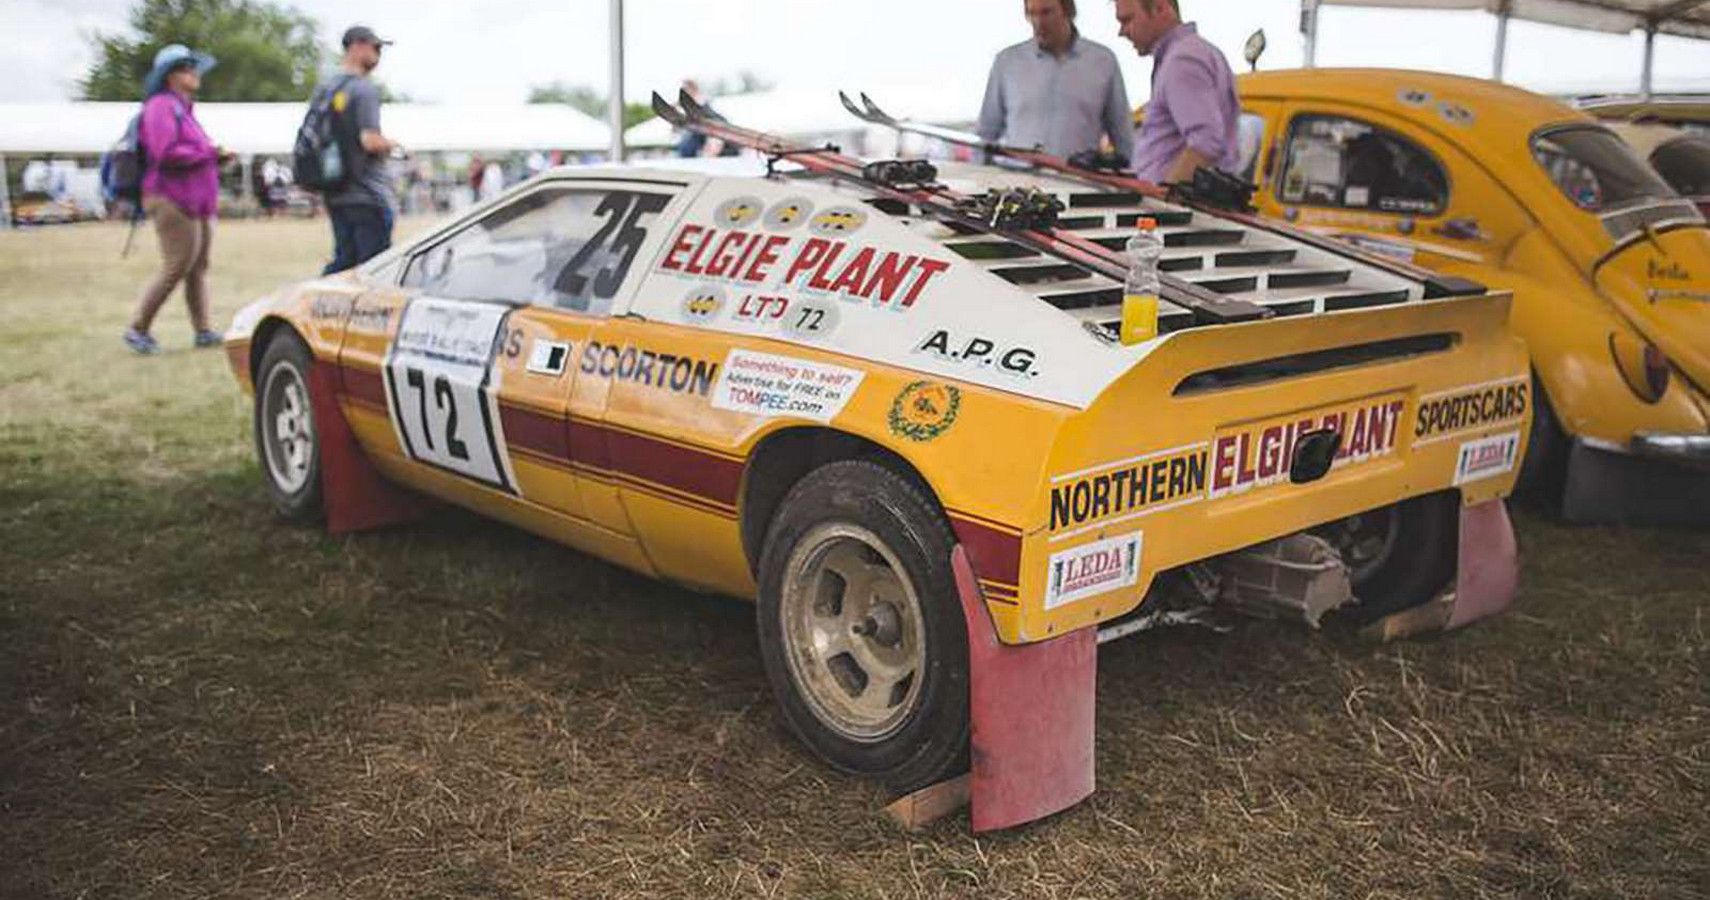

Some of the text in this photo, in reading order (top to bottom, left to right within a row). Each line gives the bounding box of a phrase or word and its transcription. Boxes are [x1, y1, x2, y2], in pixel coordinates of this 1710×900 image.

[553, 191, 674, 299] 25
[661, 223, 951, 309] ELGIE PLANT
[737, 295, 789, 319] LTD
[795, 308, 825, 331] 72
[581, 340, 719, 396] SCORTON
[733, 354, 854, 388] Something to sell?
[921, 329, 1039, 376] A.P.G.
[727, 371, 775, 389] Advertise
[793, 381, 823, 397] FREE
[729, 386, 824, 414] TOMPEE.com
[408, 367, 469, 462] 72
[1049, 450, 1208, 531] NORTHERN
[1414, 382, 1527, 437] SPORTSCARS
[1470, 440, 1506, 468] LEDA
[1065, 546, 1121, 583] LEDA
